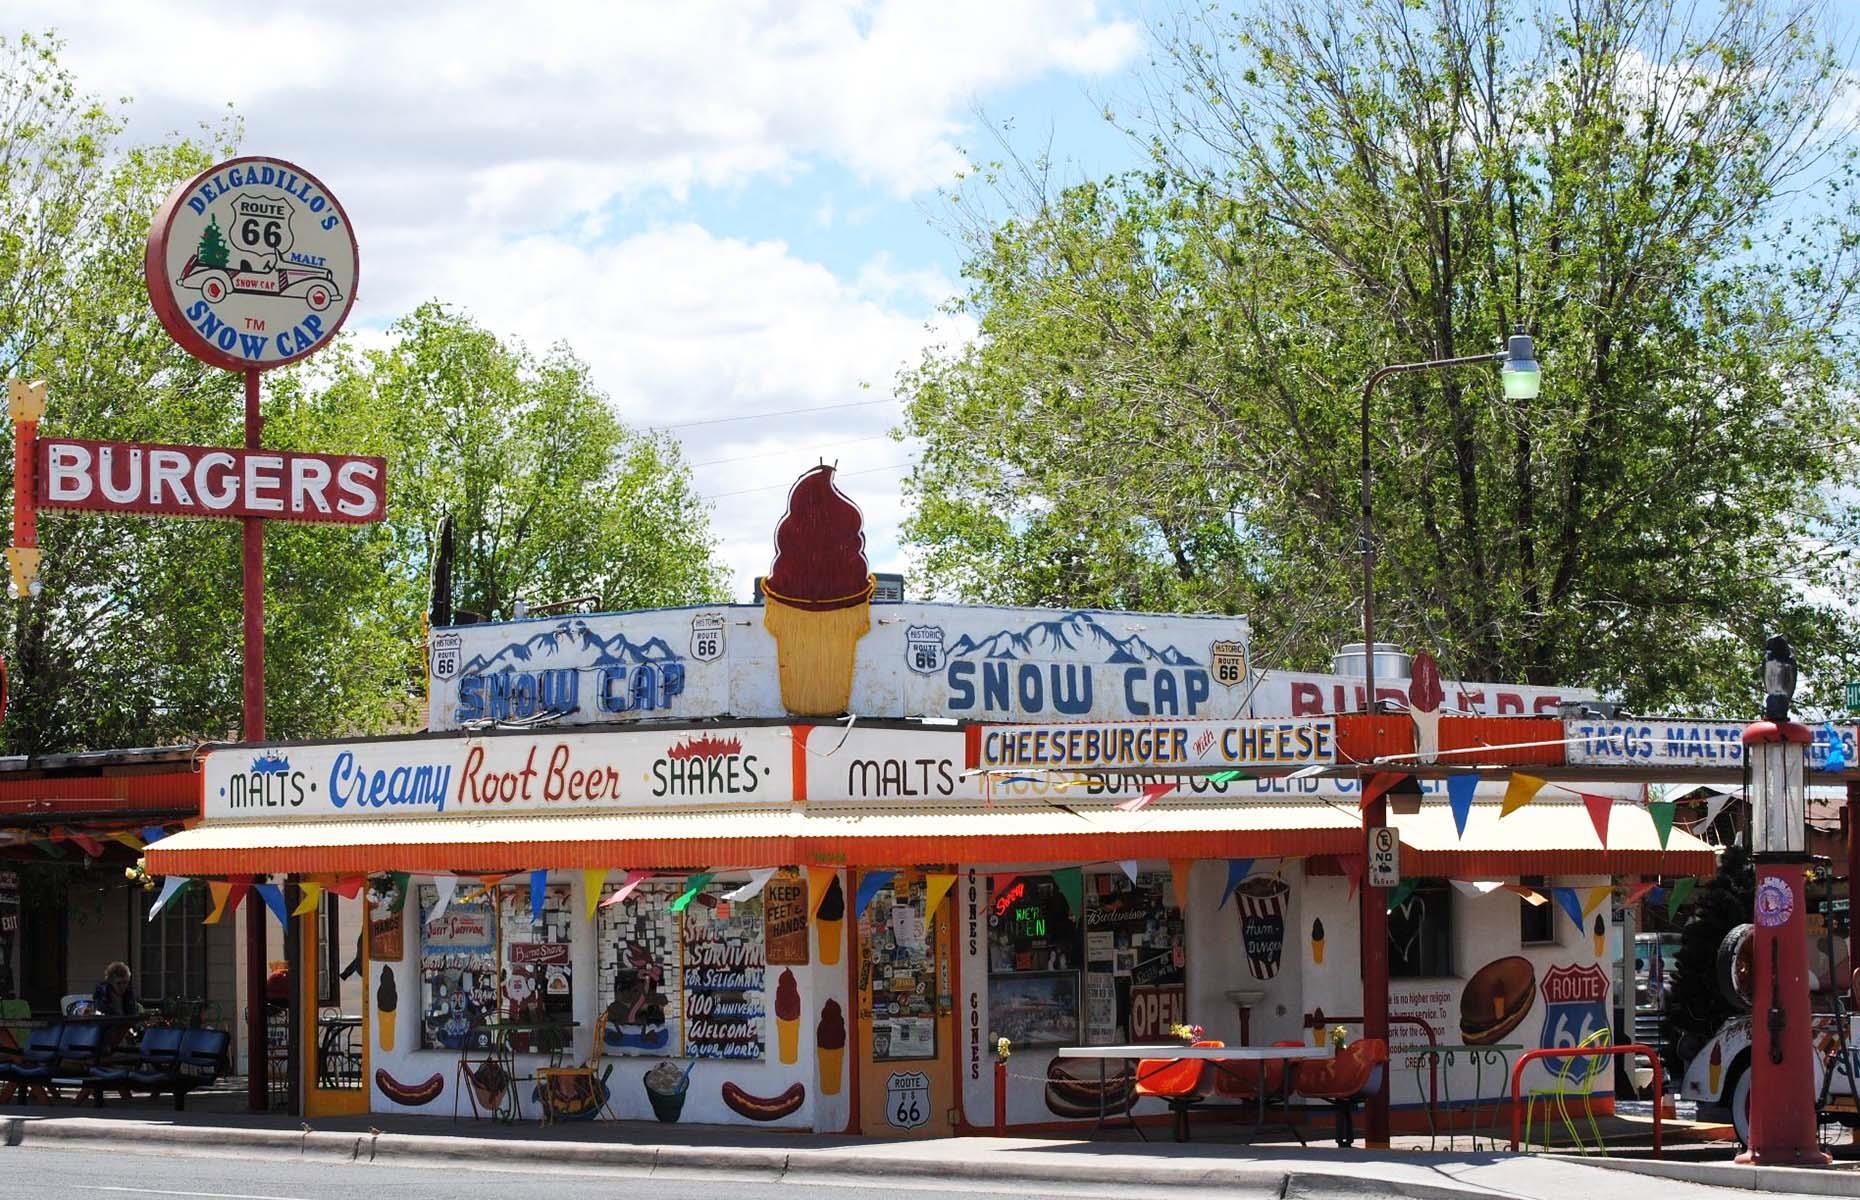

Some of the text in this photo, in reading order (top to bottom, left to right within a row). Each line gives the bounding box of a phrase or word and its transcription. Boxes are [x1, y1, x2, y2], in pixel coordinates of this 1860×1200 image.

[188, 166, 339, 231] DELGADILLO'S
[241, 202, 285, 216] ROUTE
[241, 222, 282, 252] 66
[291, 252, 327, 267] MALT
[235, 278, 276, 291] SNOW CAP
[186, 300, 324, 360] SNOW CAP
[244, 318, 265, 331] TM
[48, 443, 378, 517] BURGERS
[697, 632, 718, 640] ROUTE
[911, 630, 940, 640] HISTORIC
[438, 651, 456, 659] ROUTE
[698, 640, 716, 656] 66
[914, 644, 937, 652] ROUTE
[1215, 644, 1242, 653] HISTORIC
[438, 659, 454, 674] 66
[916, 652, 937, 669] 66
[1218, 657, 1240, 665] ROUTE
[1219, 665, 1238, 681] 66
[455, 661, 686, 724] SNOW CAP
[947, 660, 1210, 716] SNOW CAP
[1847, 686, 1860, 706] HI
[984, 723, 1336, 767] CHEESEBURGER With CHEESE
[1580, 727, 1742, 759] TACOS MALTS
[230, 743, 758, 812] MALTS Creamy Root Beer SHAKES
[849, 758, 954, 797] MALTS
[1376, 853, 1392, 862] NO
[769, 886, 800, 900] KEEP
[768, 903, 791, 922] FEET
[968, 868, 977, 956] CONES
[1087, 907, 1147, 926] Budweiser
[773, 916, 807, 937] HANDS
[1553, 976, 1601, 1001] ROUTE
[689, 992, 713, 1017] 100
[1409, 991, 1429, 1006] higher
[1133, 993, 1185, 1038] OPEN
[689, 1020, 757, 1040] WELCOME
[970, 992, 980, 1080] CONES
[1419, 1026, 1446, 1038] coon
[1553, 1011, 1603, 1062] 66
[895, 1077, 921, 1089] ROUTE
[896, 1100, 921, 1122] 66
